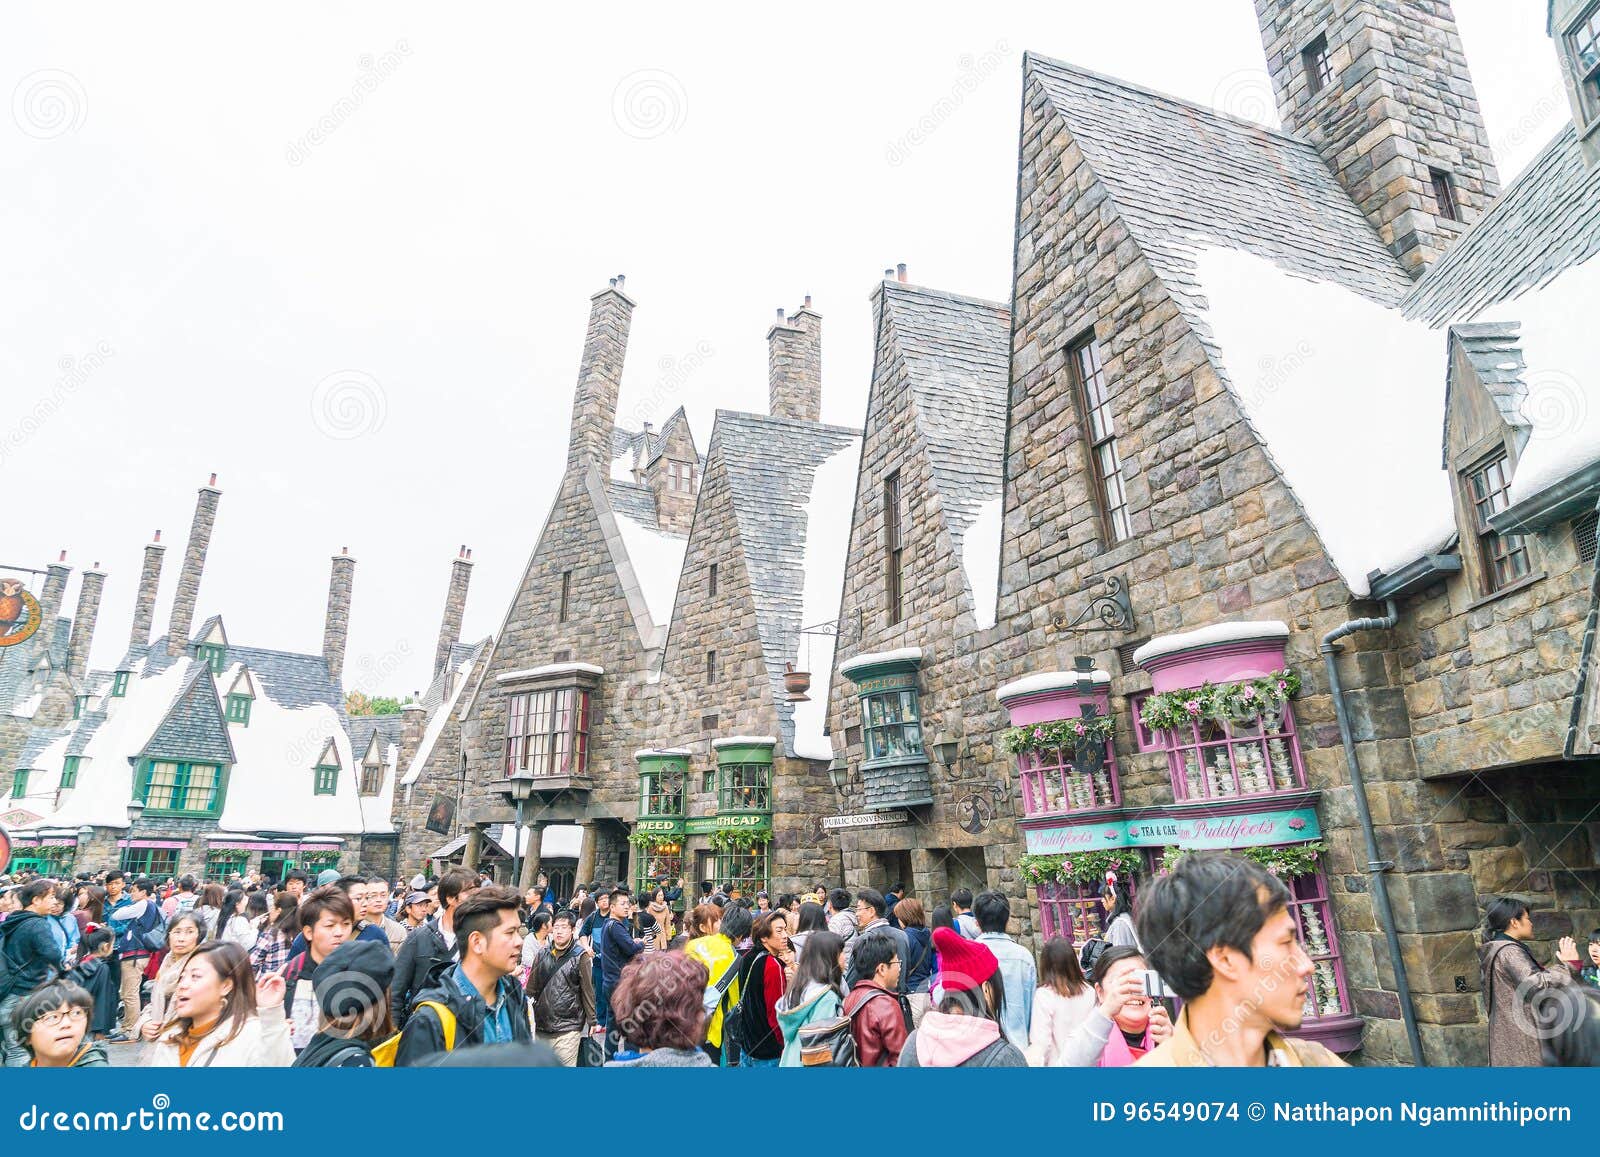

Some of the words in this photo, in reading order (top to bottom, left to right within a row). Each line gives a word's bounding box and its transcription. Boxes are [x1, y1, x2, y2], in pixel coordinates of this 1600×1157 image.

[824, 817, 850, 826] PUBLIC
[1141, 826, 1154, 837] TEA
[1163, 825, 1178, 836] CAK
